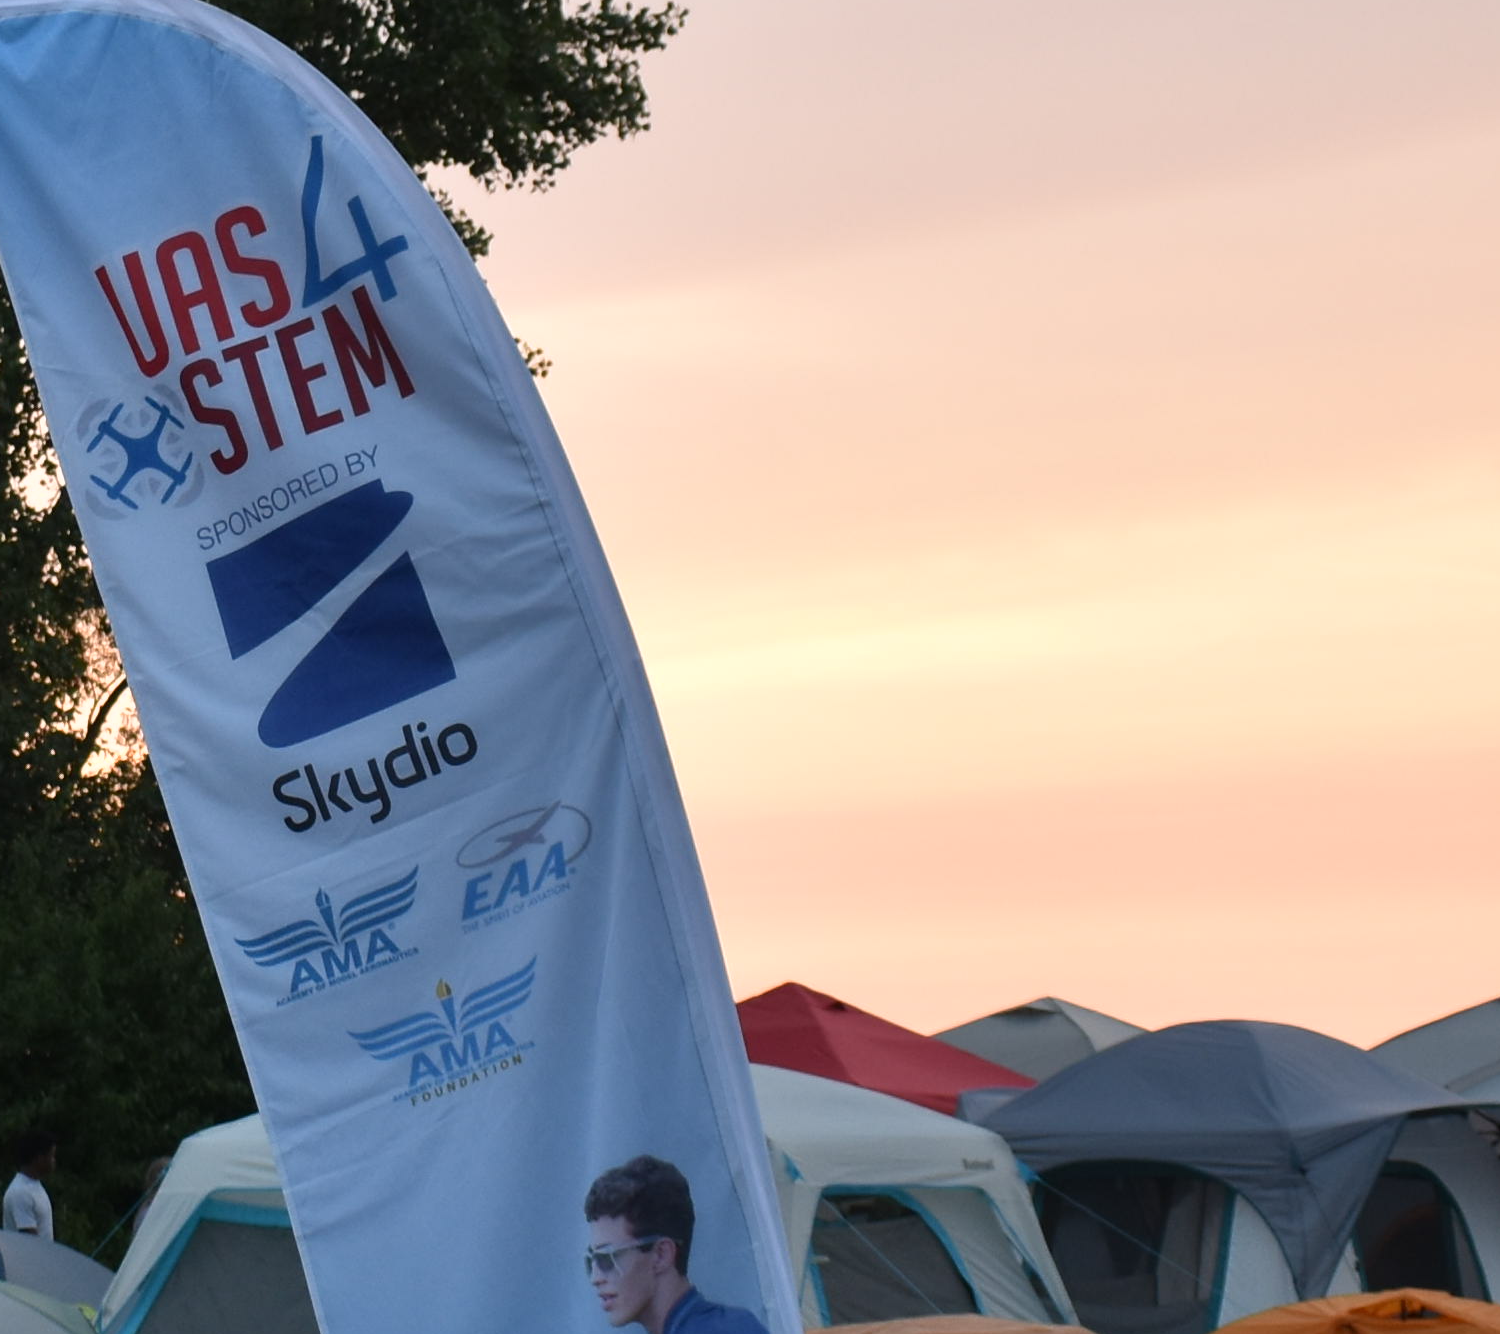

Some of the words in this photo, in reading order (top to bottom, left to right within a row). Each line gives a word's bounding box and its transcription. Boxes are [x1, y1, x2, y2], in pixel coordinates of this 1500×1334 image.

[95, 205, 292, 378] UAS
[302, 135, 408, 309] 4
[179, 284, 416, 476] STEM
[196, 462, 340, 550] SPONSORED
[344, 444, 379, 476] BY
[272, 721, 478, 833] Skydio
[461, 840, 567, 921] EAA
[290, 927, 400, 994] AMA
[408, 1020, 516, 1088] AMA
[410, 1054, 523, 1107] FOUNDATION
